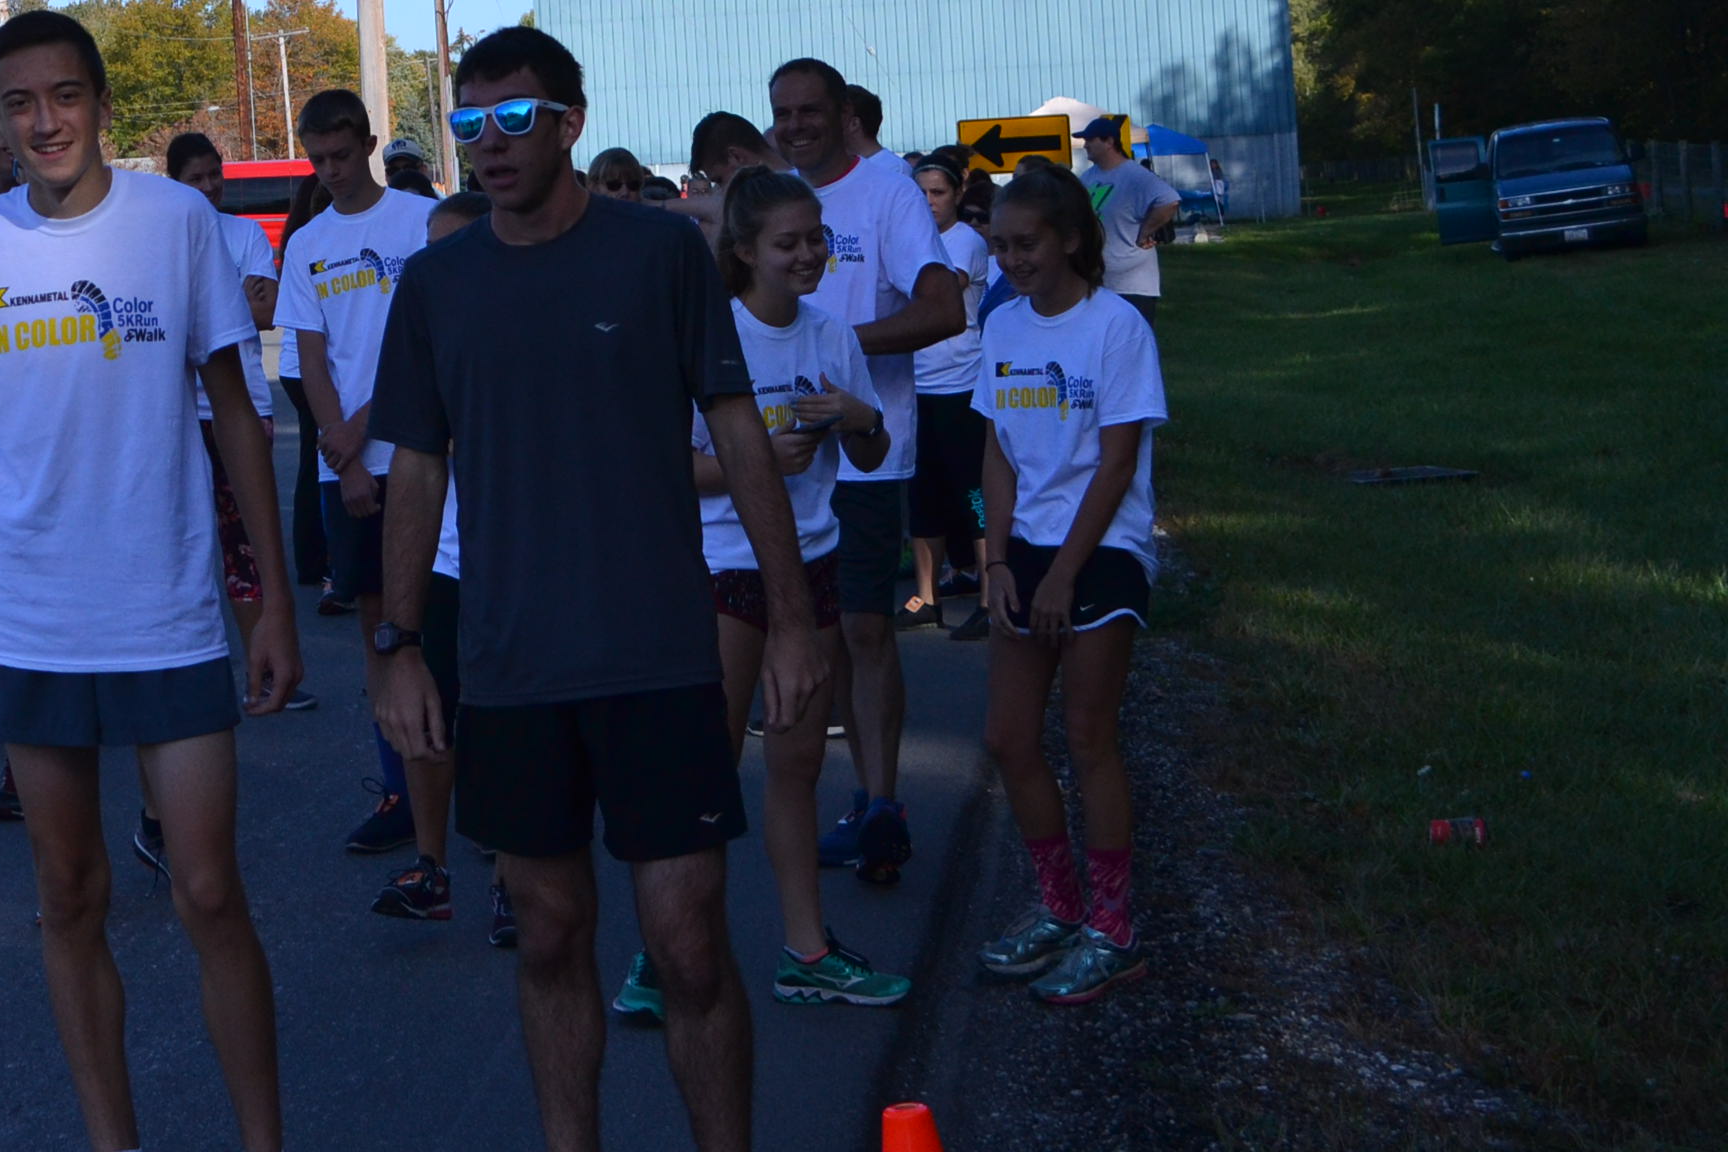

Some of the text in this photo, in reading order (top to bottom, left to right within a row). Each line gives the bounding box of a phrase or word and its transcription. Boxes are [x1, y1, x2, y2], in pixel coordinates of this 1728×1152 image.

[835, 233, 859, 245] Color
[384, 256, 405, 267] Colo
[331, 267, 376, 295] COLOR
[10, 291, 69, 307] KENNAMETAL
[112, 297, 154, 314] Color
[14, 314, 97, 351] COLOR
[1067, 376, 1093, 388] Color
[1008, 386, 1057, 409] COLOR
